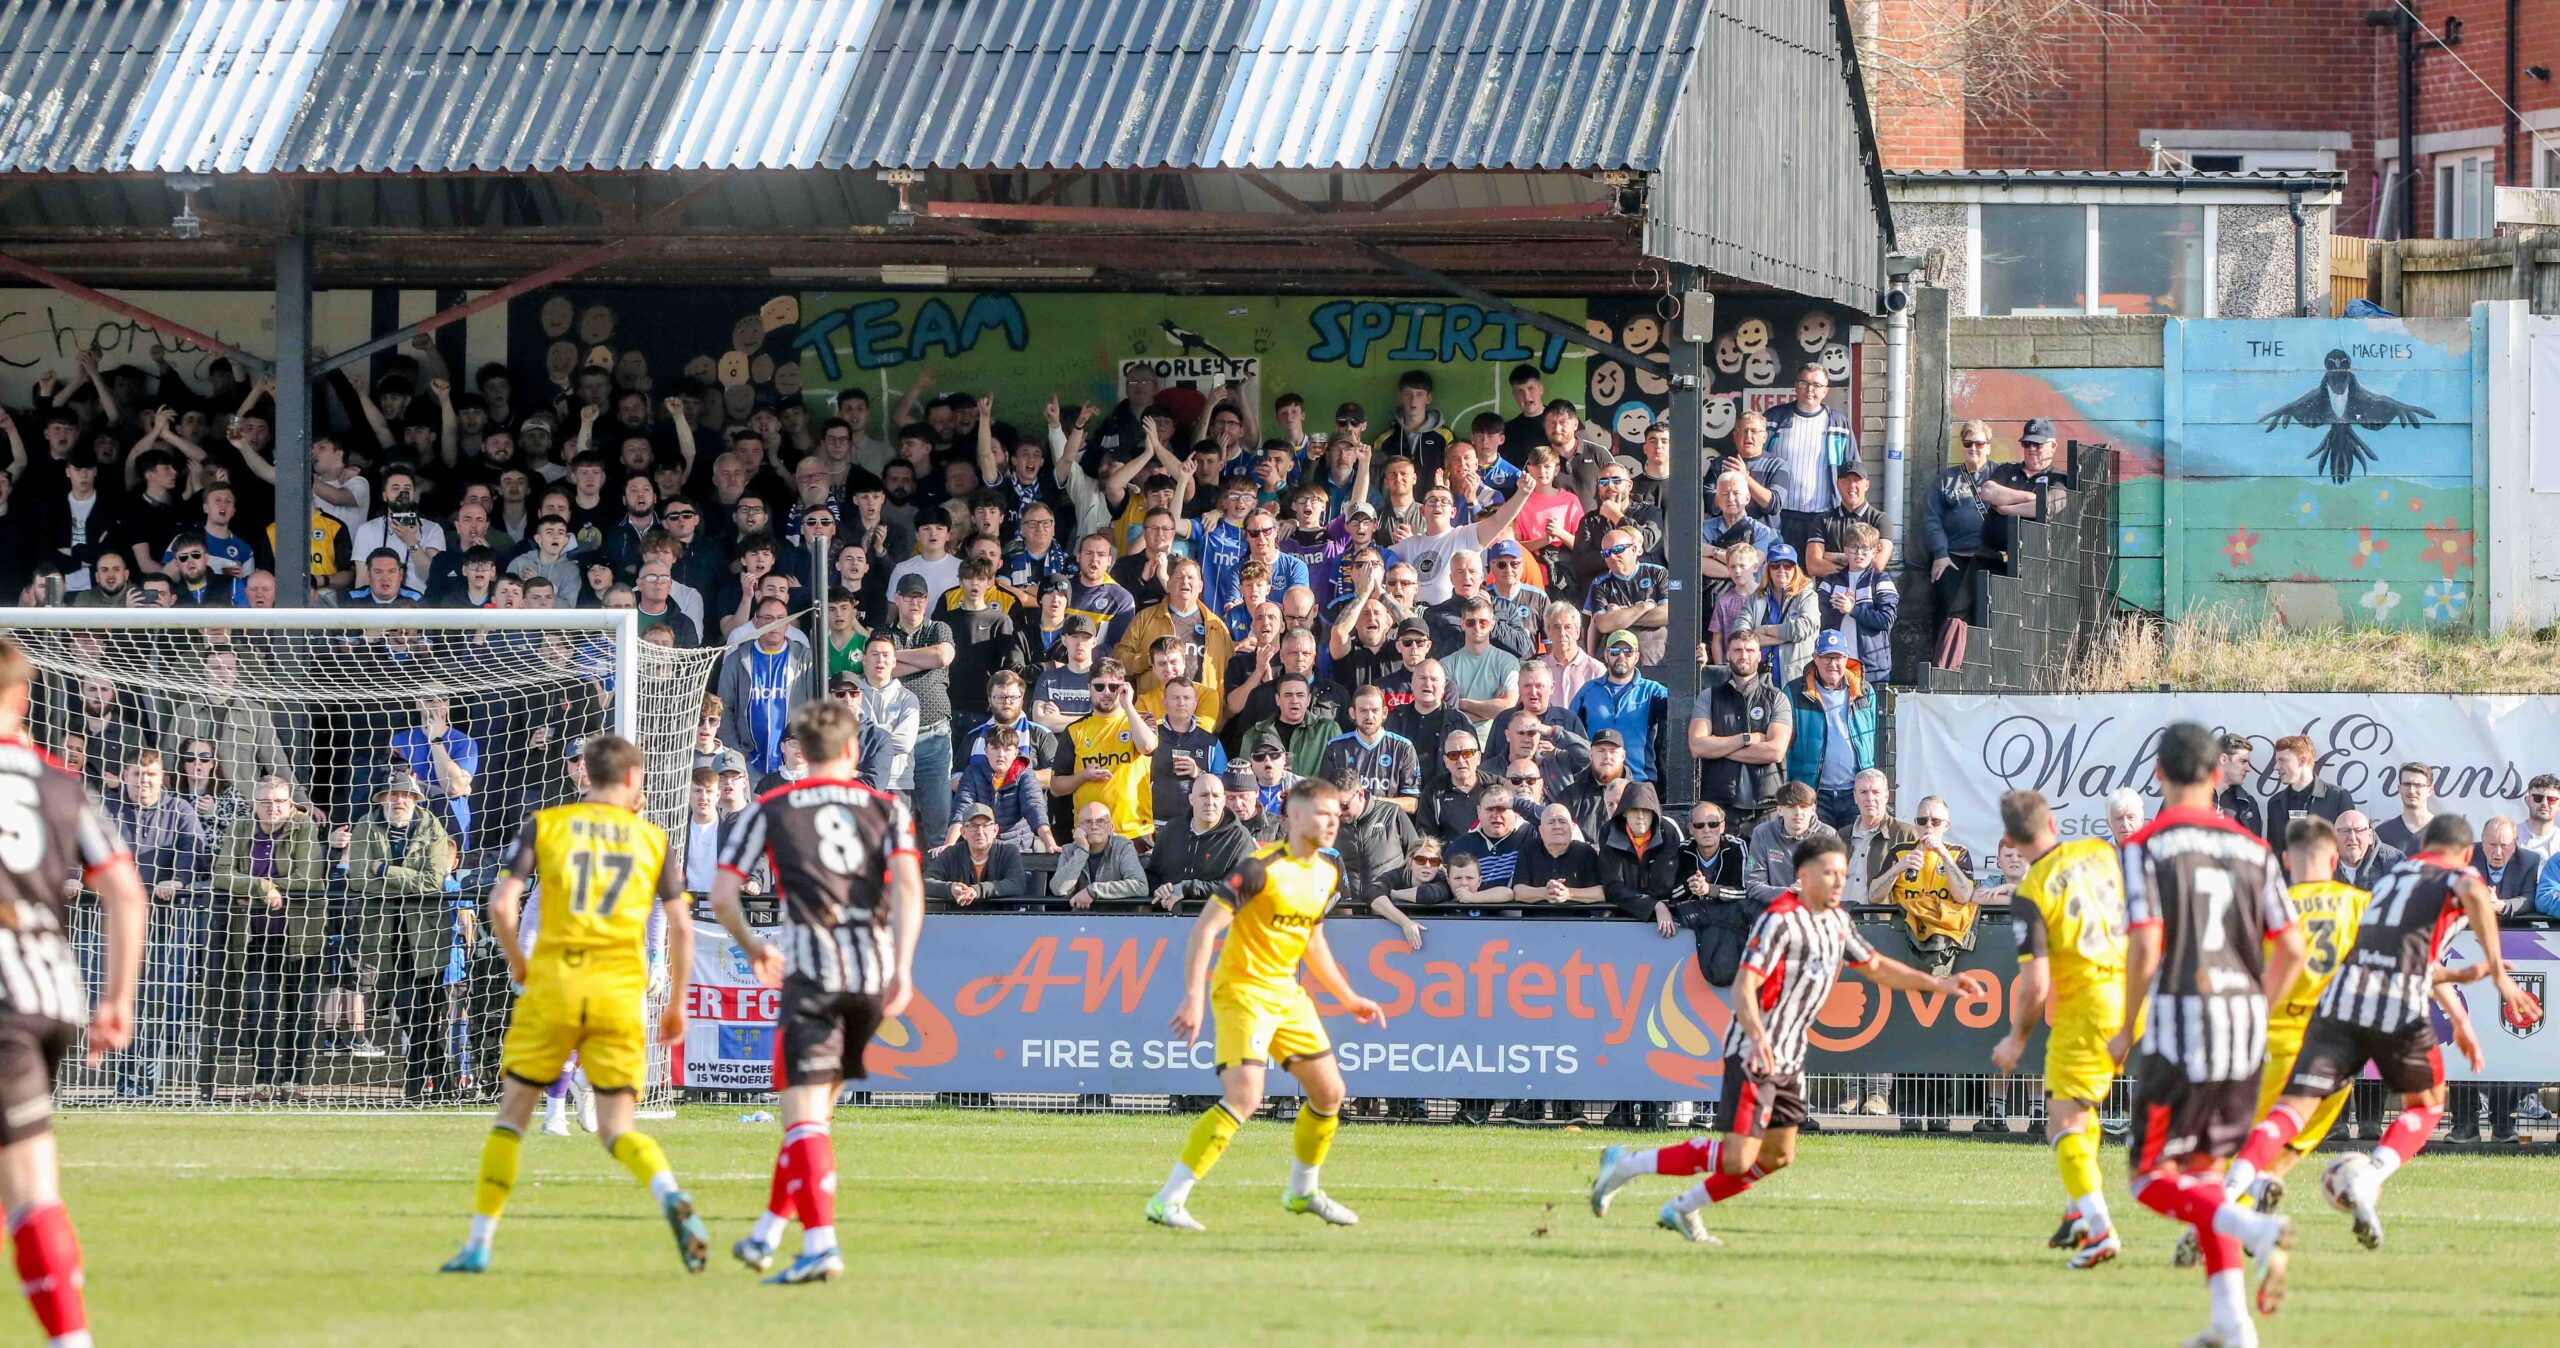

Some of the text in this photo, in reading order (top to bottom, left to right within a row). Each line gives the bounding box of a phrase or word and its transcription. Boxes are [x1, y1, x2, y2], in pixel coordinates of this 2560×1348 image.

[788, 290, 1030, 382] TEAM
[2247, 340, 2413, 360] THE MAGPIES
[1123, 357, 1257, 378] CORLEY FC
[1082, 750, 1131, 769] mbna
[1983, 714, 2166, 809] Wals
[814, 804, 865, 875] 8
[571, 850, 634, 918] 17
[2194, 866, 2234, 952] 7
[2360, 873, 2422, 926] 21
[2306, 918, 2336, 976] 3
[1367, 939, 1652, 1045] Safety
[688, 1062, 774, 1074] OH WEST CHES
[697, 1073, 775, 1084] IS WONDERF
[1022, 1040, 1099, 1068] FIRE
[1109, 1040, 1133, 1068] &
[1338, 1042, 1579, 1074] SPECIALISTS
